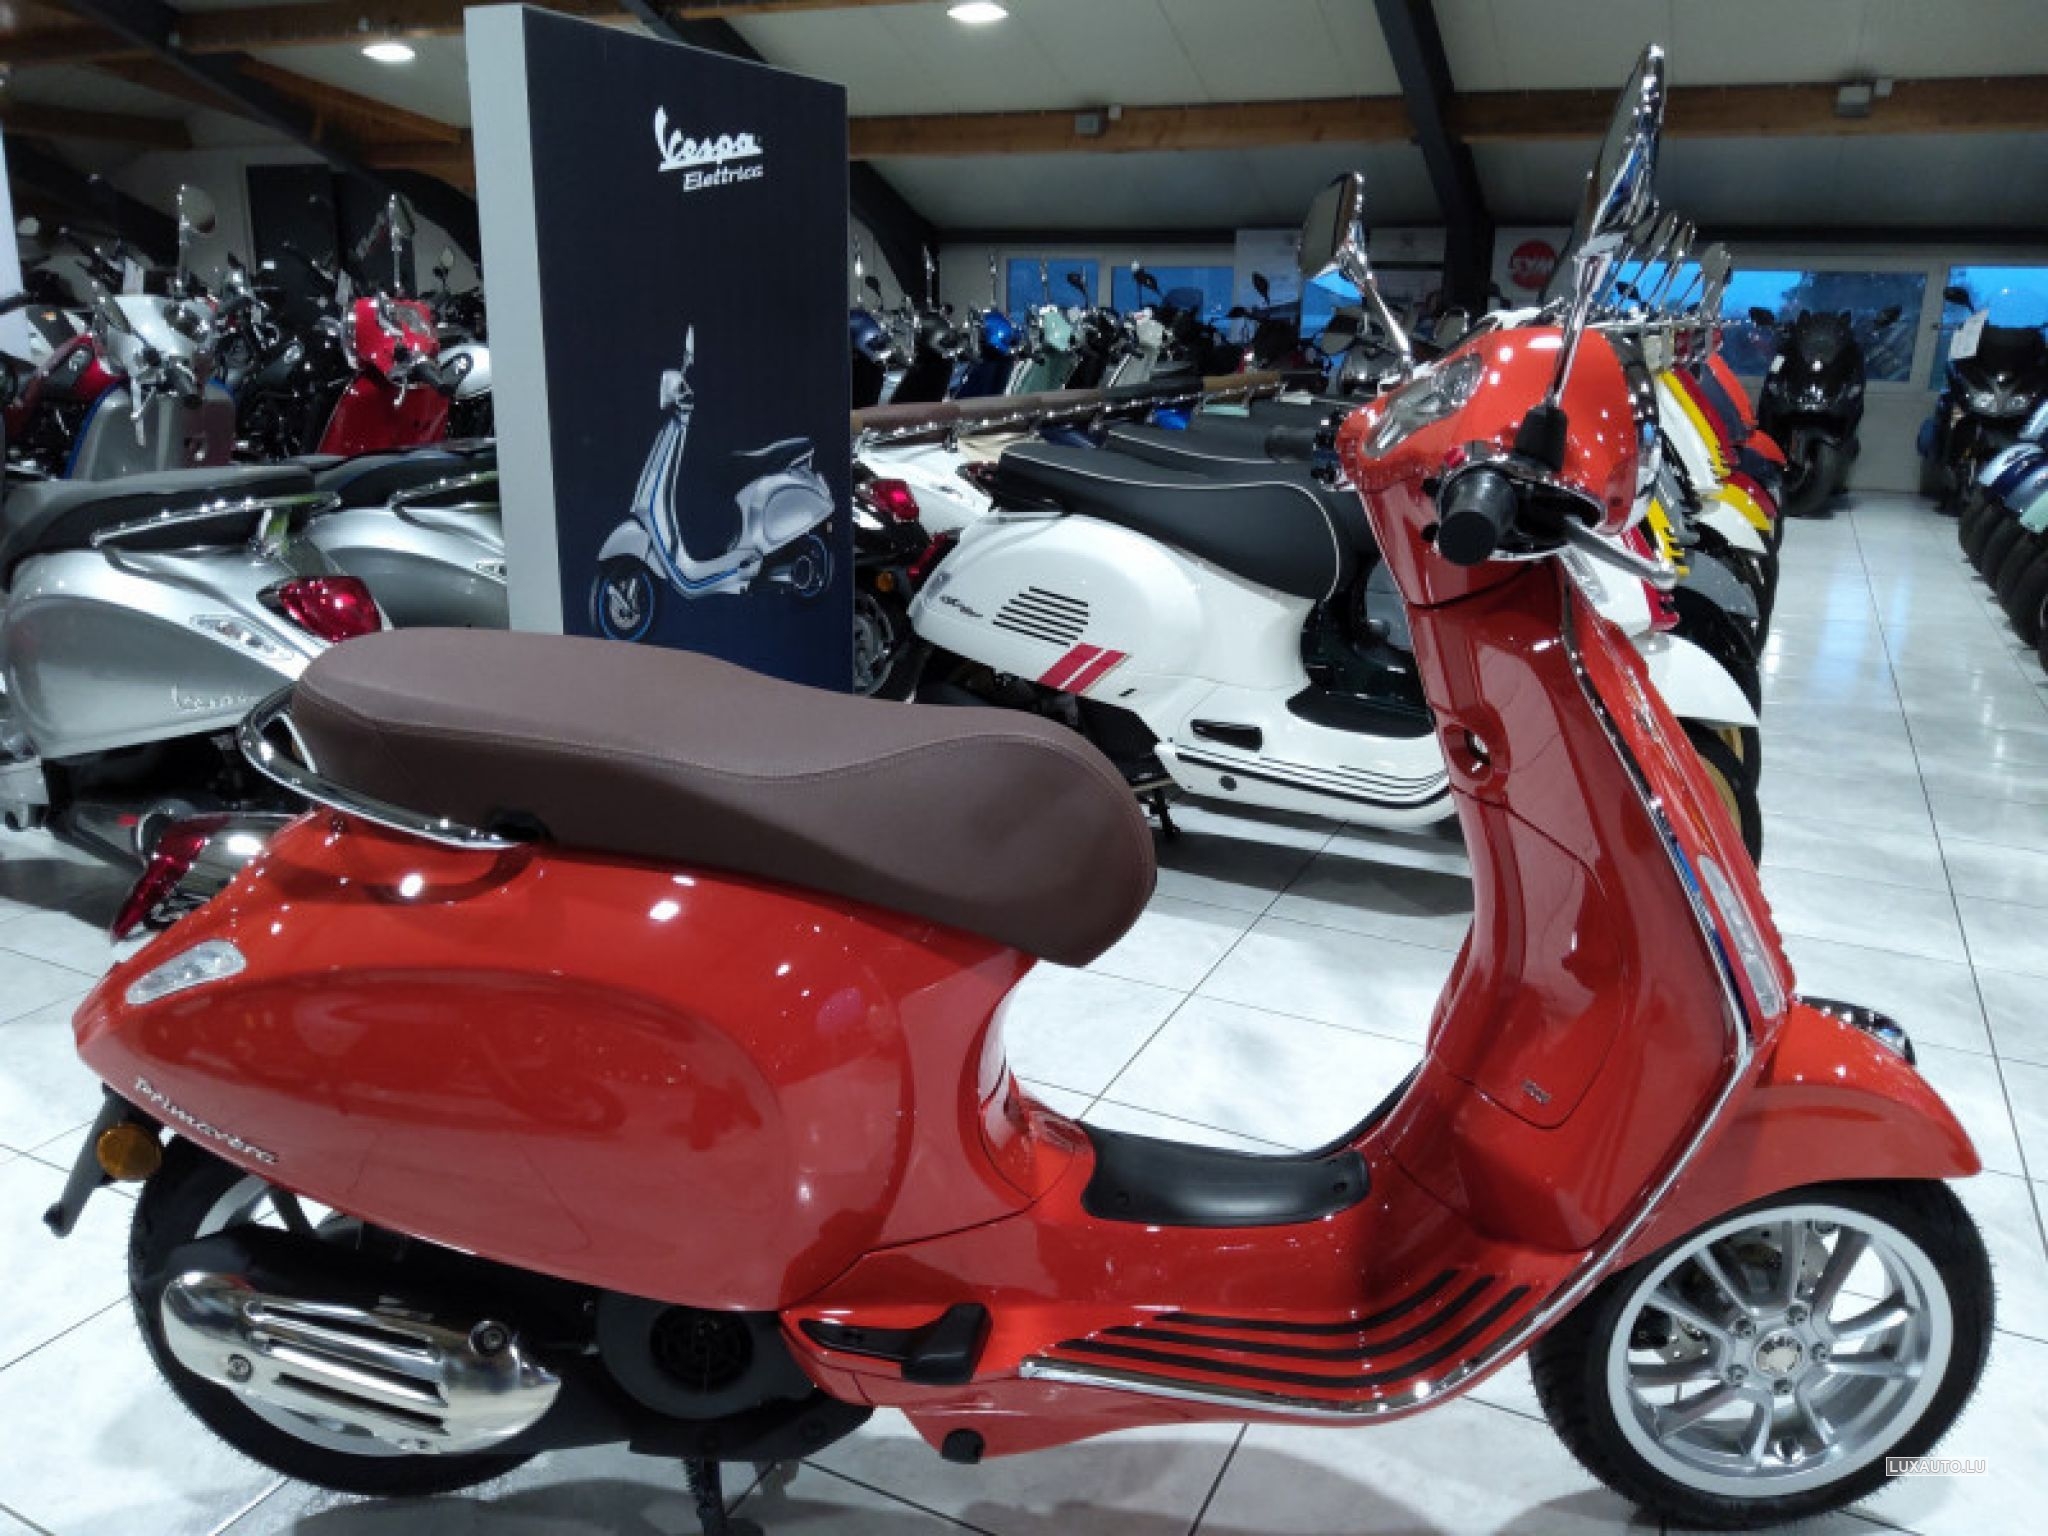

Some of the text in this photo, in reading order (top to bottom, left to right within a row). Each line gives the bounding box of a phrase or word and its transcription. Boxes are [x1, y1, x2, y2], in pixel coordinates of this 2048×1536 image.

[655, 105, 763, 171] Vespa
[683, 164, 763, 192] Elettrica
[135, 1076, 278, 1165] Primavera
